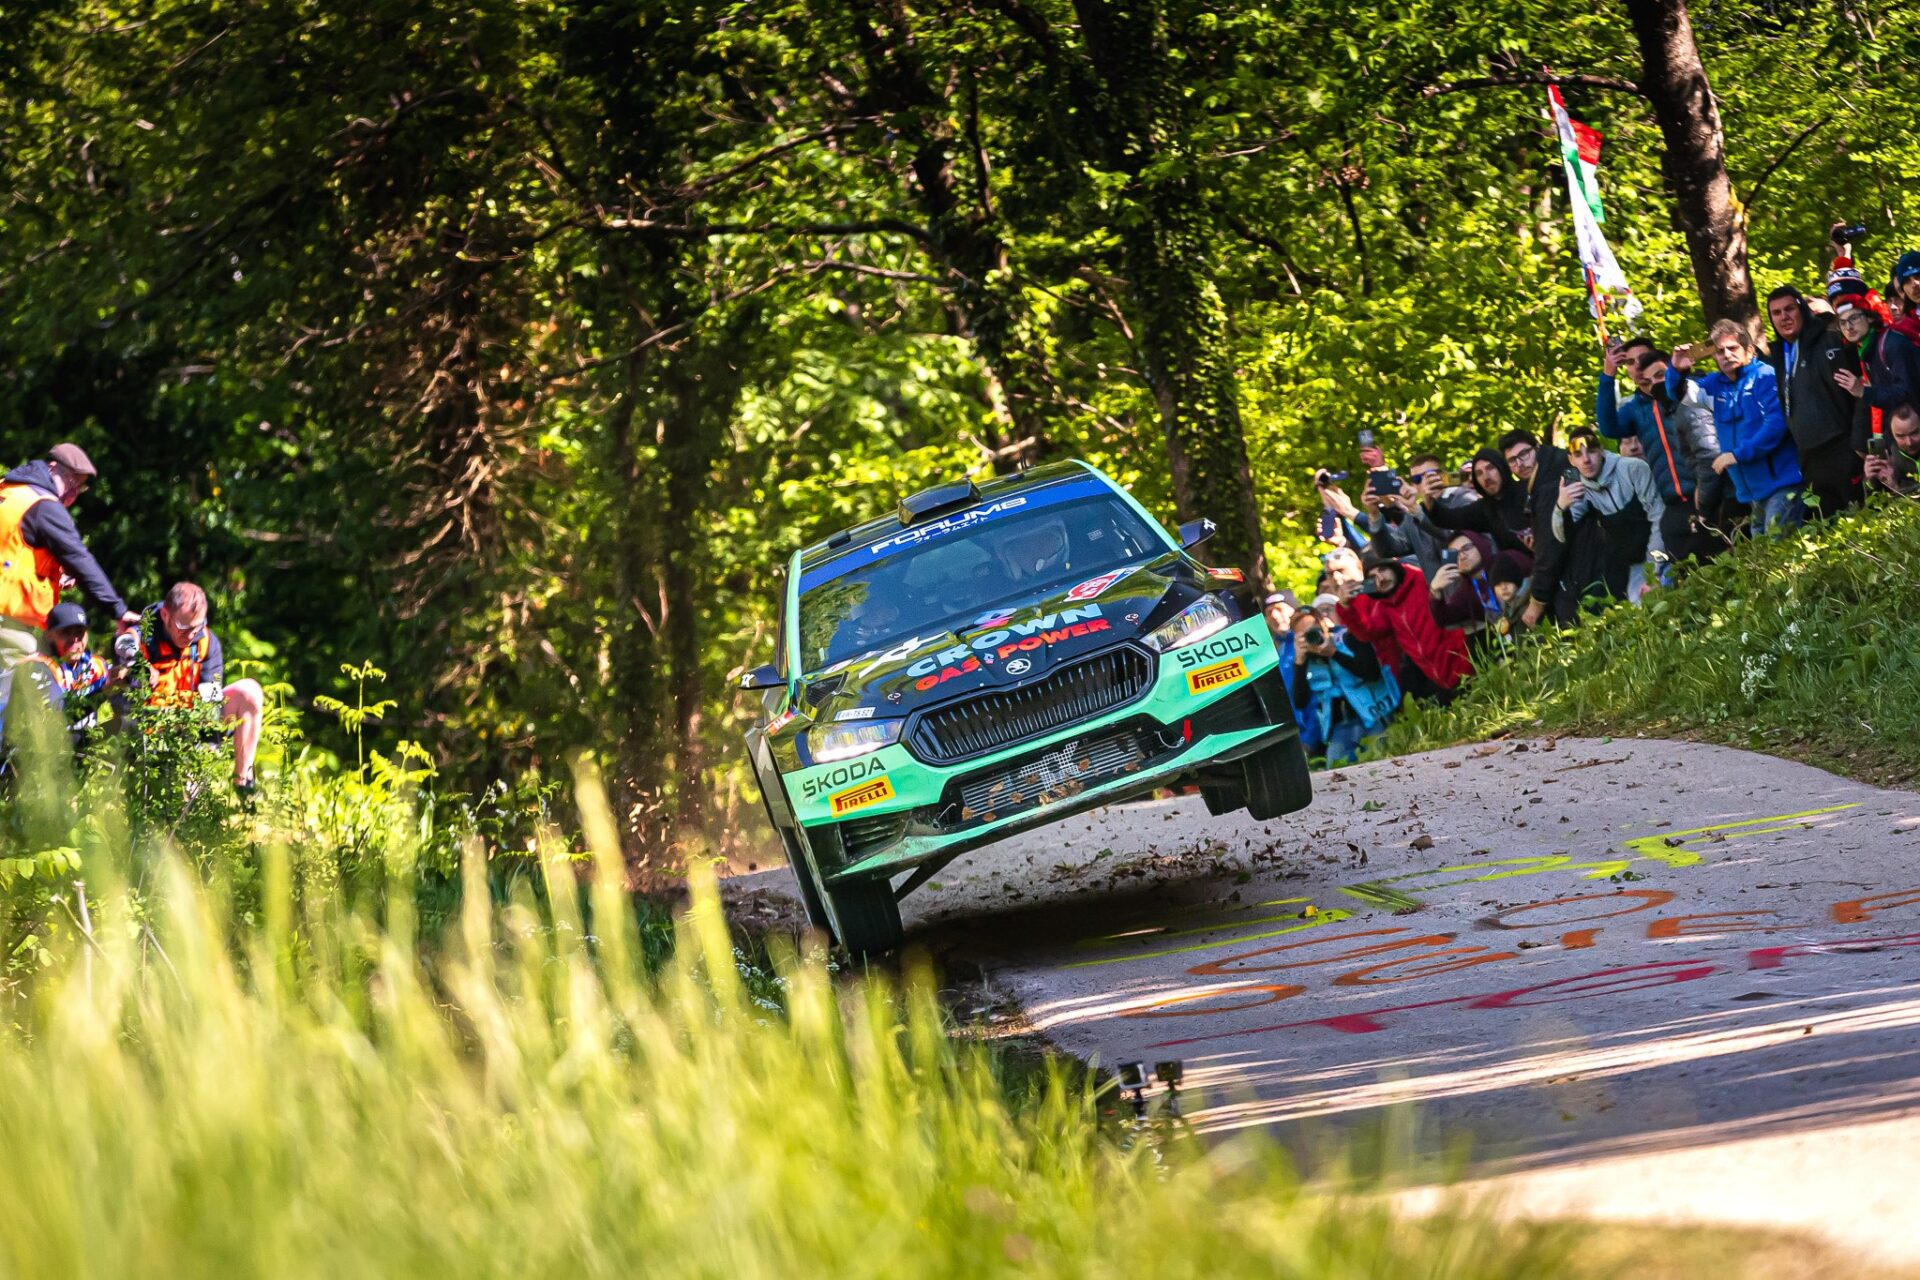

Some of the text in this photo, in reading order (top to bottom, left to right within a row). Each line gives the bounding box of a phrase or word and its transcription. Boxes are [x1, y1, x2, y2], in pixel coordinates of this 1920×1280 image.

[871, 497, 1027, 554] FORUM8
[906, 603, 1103, 677] CROWN
[996, 619, 1112, 659] POWER
[1192, 662, 1242, 689] PIRELLI
[834, 781, 887, 812] PIRELLI
